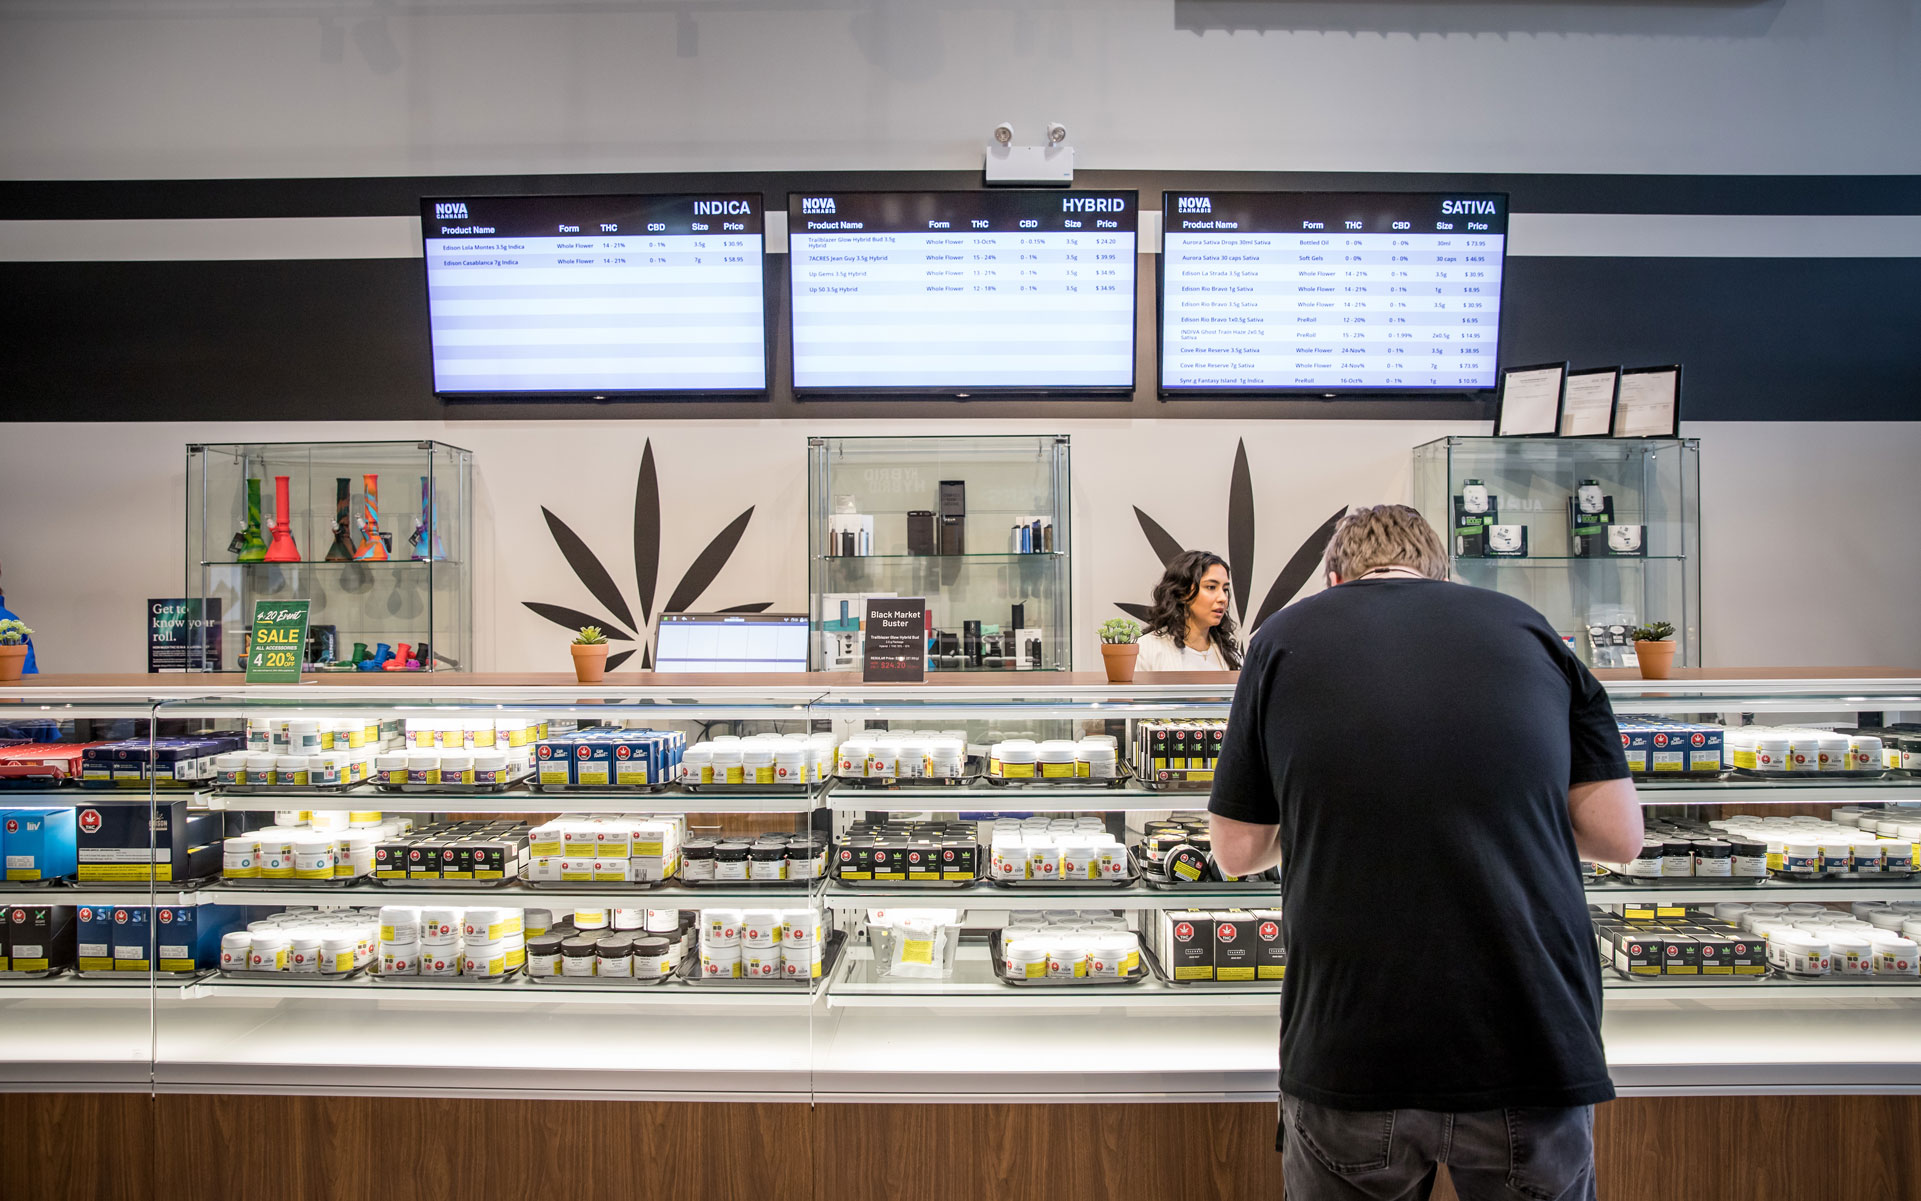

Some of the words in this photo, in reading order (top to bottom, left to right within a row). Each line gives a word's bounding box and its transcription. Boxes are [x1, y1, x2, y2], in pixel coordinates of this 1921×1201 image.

[802, 198, 836, 209] NOVA
[1062, 198, 1125, 212] HYBRID
[1178, 197, 1211, 208] NOVA
[435, 203, 468, 214] NOVA
[693, 201, 751, 215] INDICA
[1441, 200, 1496, 215] SATIVA
[600, 223, 618, 232] THC
[647, 223, 666, 232] CBD
[691, 223, 709, 231] Size
[723, 222, 744, 231] Price
[807, 221, 839, 230] Product
[840, 221, 864, 229] Name
[928, 219, 950, 228] Form
[971, 219, 989, 228] THC
[1019, 219, 1038, 228] CBD
[1064, 219, 1082, 228] Size
[1096, 219, 1118, 228] Price
[1182, 220, 1214, 230] Product
[1215, 221, 1238, 229] Name
[1303, 221, 1324, 230] Form
[1345, 221, 1363, 230] THC
[1392, 221, 1411, 230] CBD
[1436, 221, 1453, 230] Size
[1467, 222, 1488, 231] Price
[441, 226, 473, 235] Product
[473, 225, 496, 234] Name
[558, 224, 580, 233] Form
[152, 603, 174, 614] Get
[176, 605, 189, 614] to
[276, 609, 308, 622] Event
[870, 611, 893, 619] Black
[894, 611, 921, 619] Market
[152, 617, 185, 628] know
[152, 631, 177, 642] roll.
[257, 629, 300, 643] SALE
[253, 653, 263, 667] 4
[881, 661, 906, 669] $24.20
